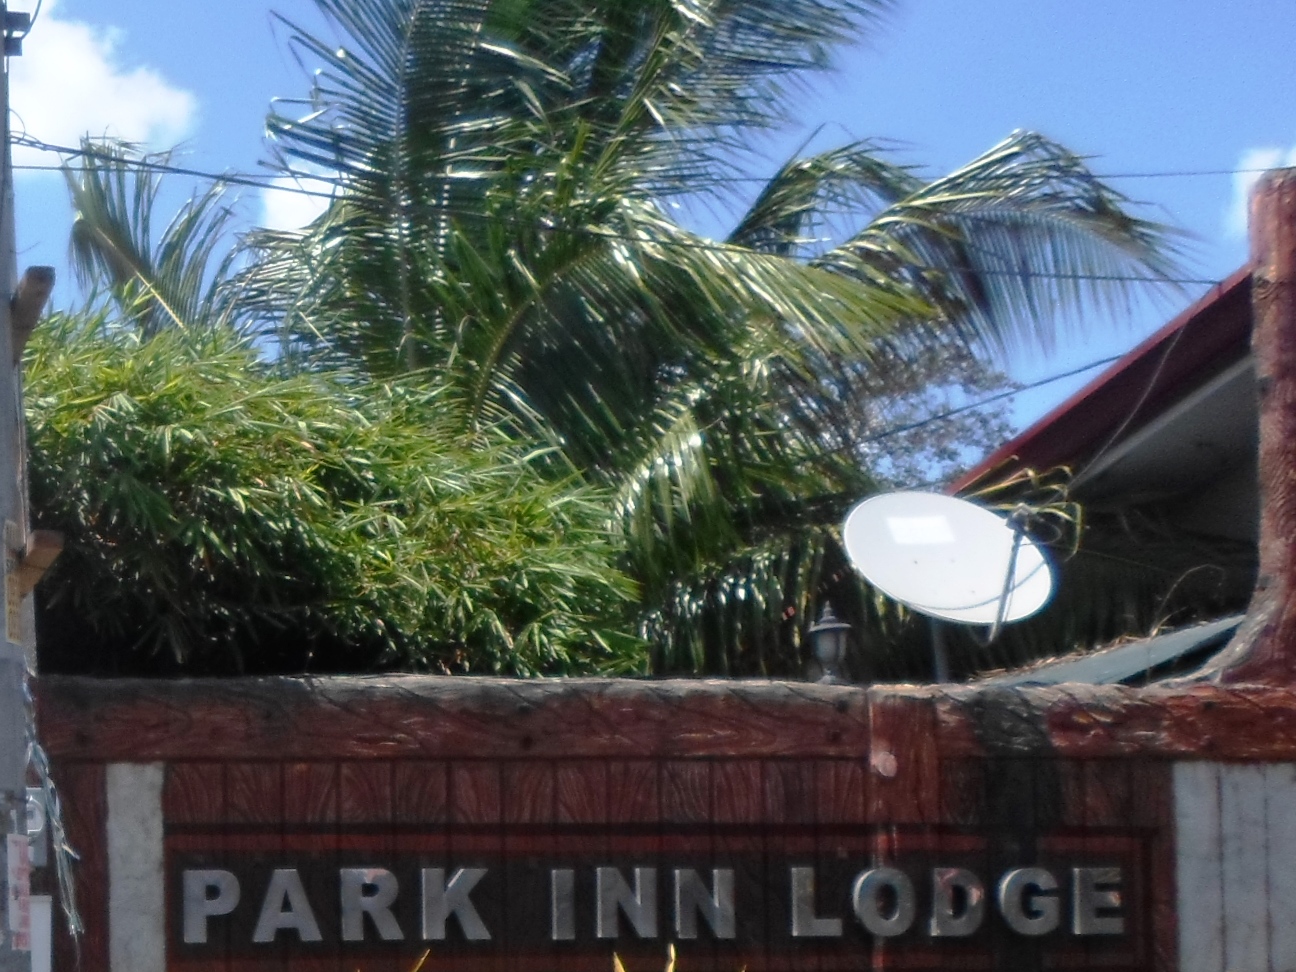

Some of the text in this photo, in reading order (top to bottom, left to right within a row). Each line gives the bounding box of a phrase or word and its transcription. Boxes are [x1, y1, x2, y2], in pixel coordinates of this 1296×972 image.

[182, 866, 1126, 944] PARK INN LODGE
